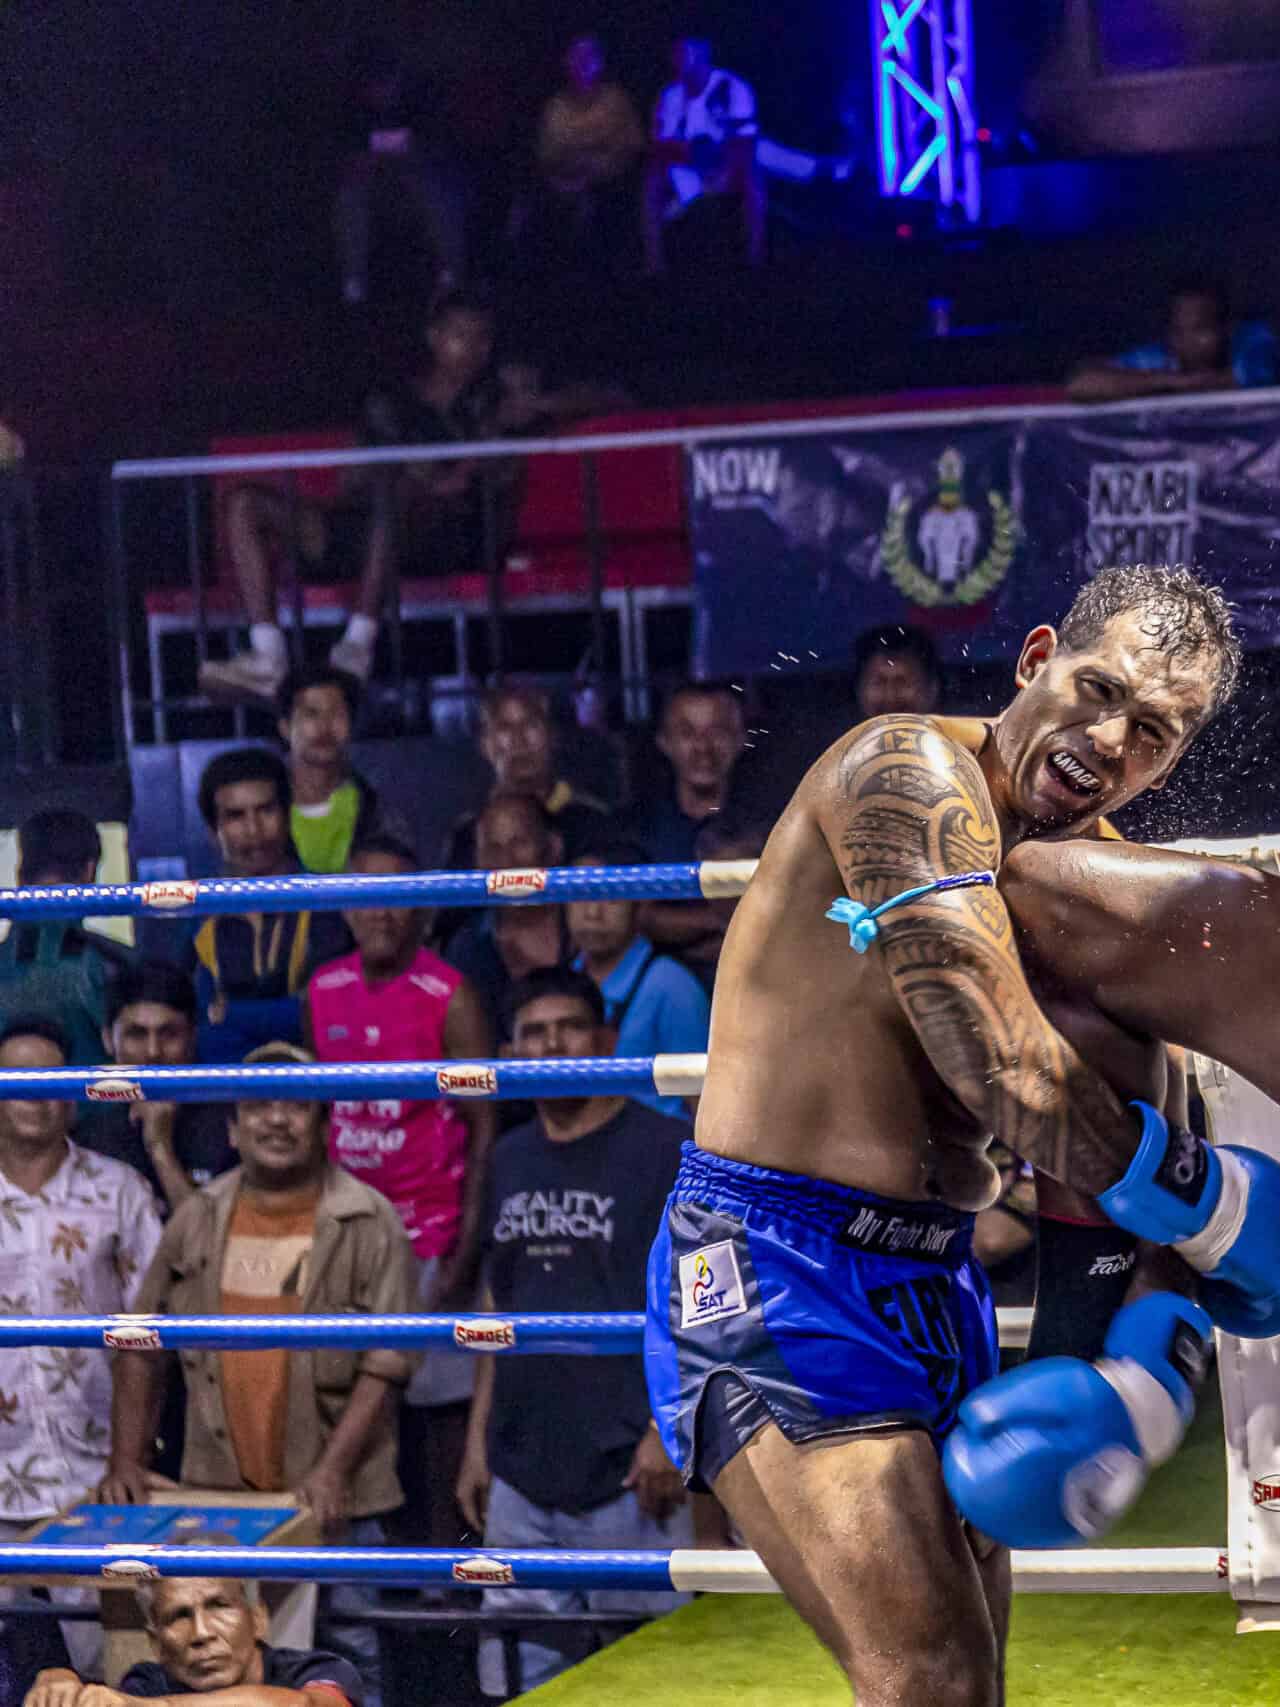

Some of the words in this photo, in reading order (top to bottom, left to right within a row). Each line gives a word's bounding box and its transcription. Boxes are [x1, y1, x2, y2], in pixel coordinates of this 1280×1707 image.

[692, 448, 781, 500] NOW
[438, 1072, 496, 1092] SANDEE
[848, 1211, 883, 1246] My
[699, 1290, 727, 1308] SAT
[456, 1325, 513, 1345] SANDEE
